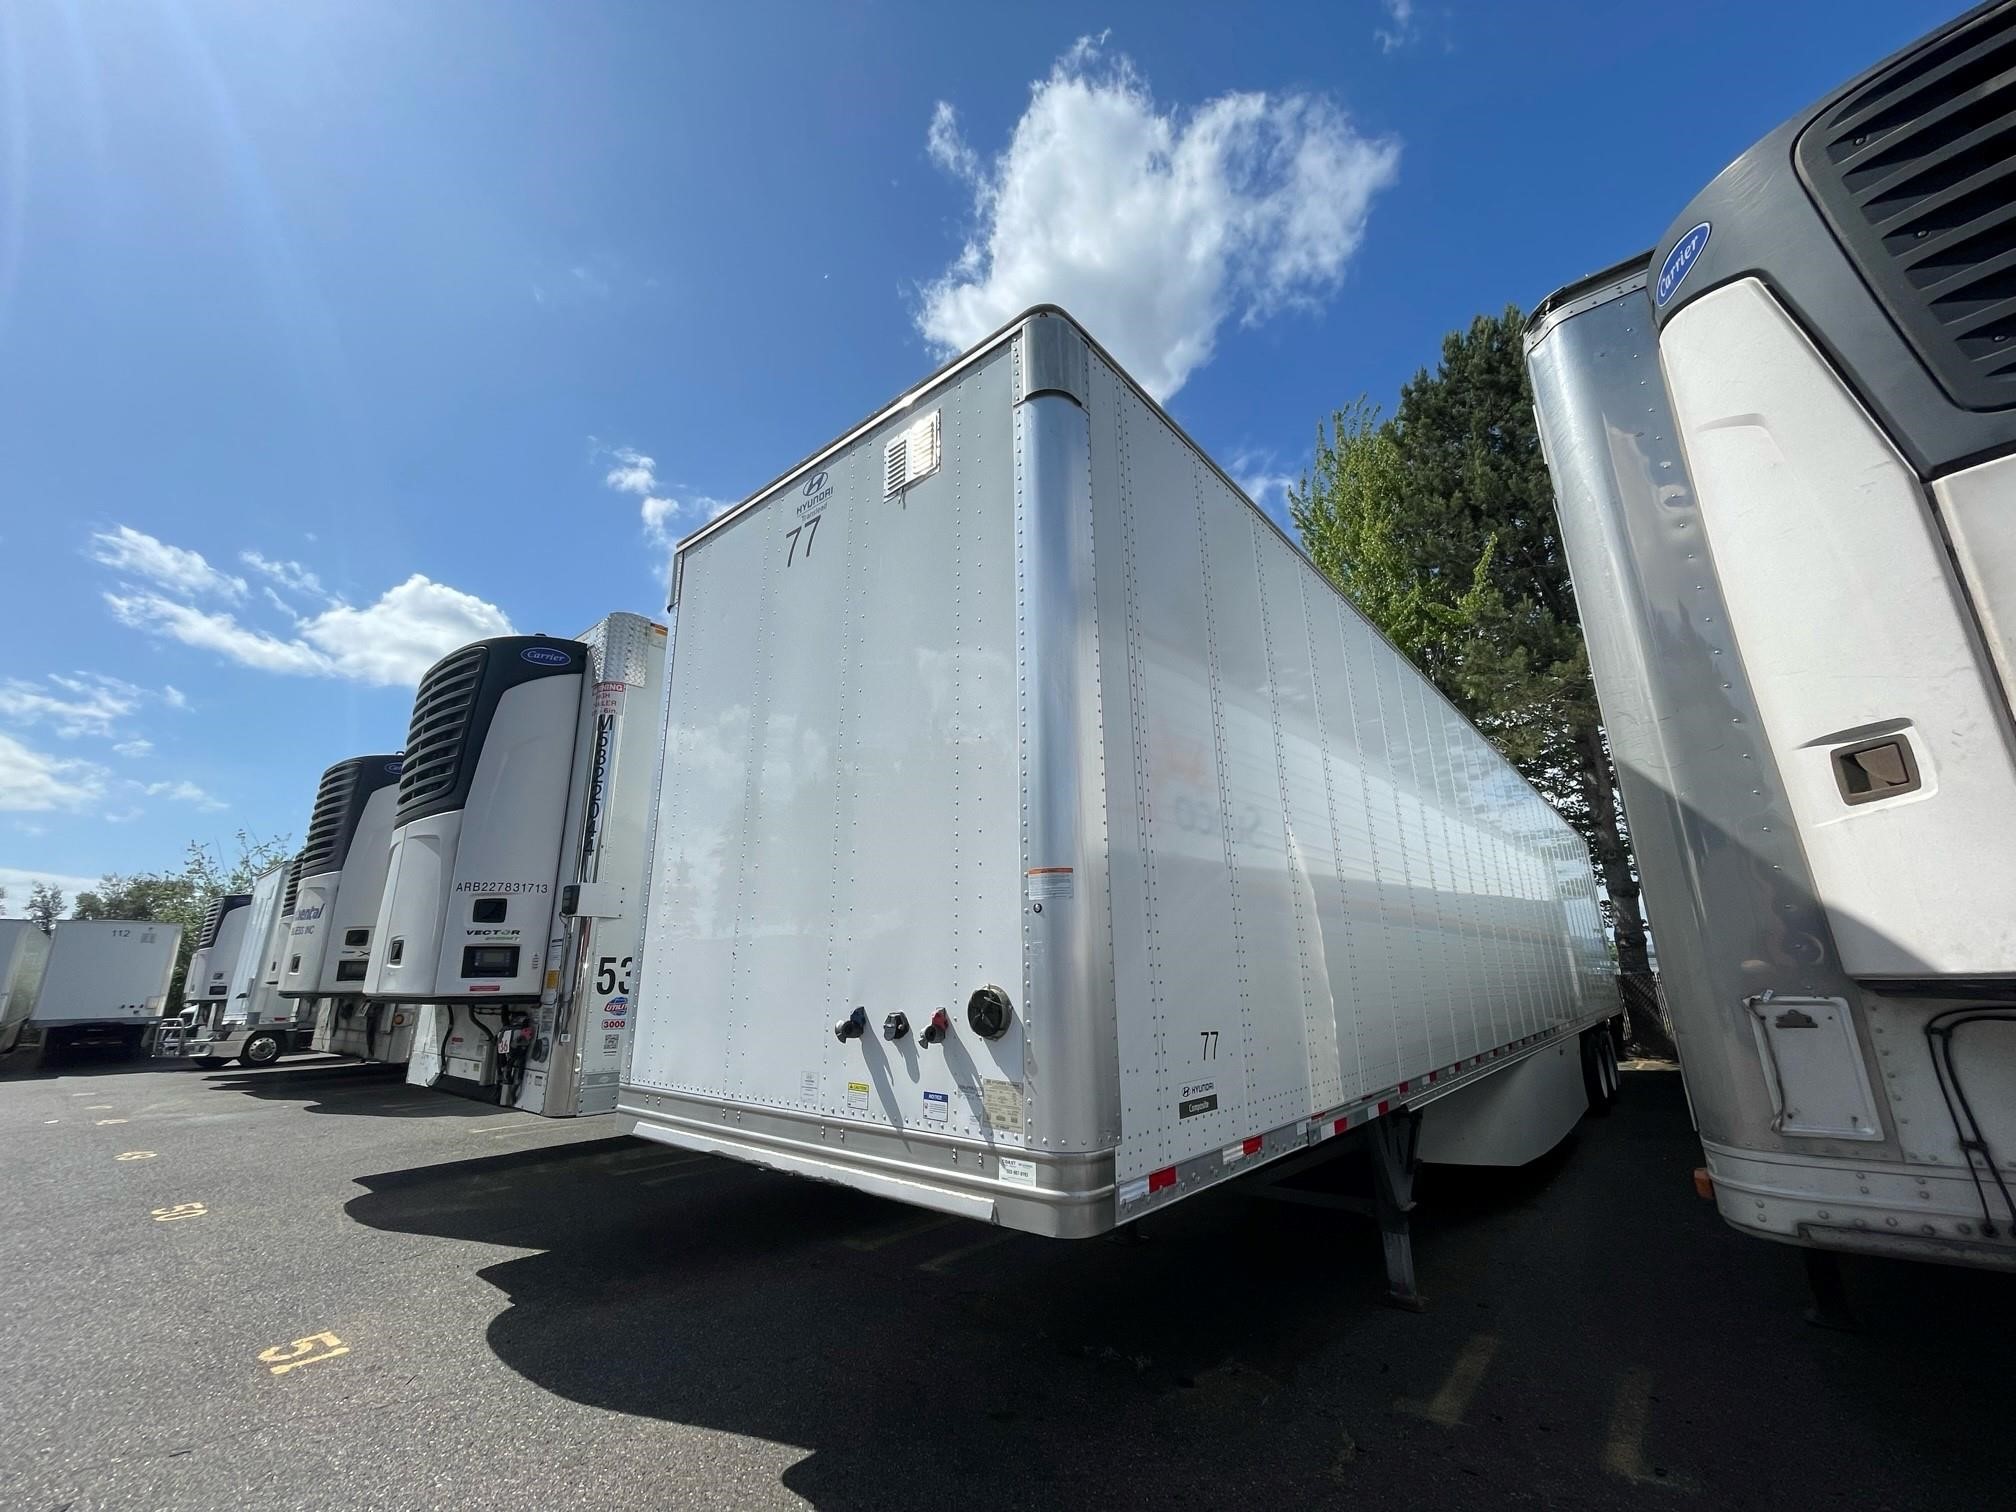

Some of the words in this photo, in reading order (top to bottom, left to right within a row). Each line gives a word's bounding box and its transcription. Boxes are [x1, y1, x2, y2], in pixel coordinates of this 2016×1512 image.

[1660, 235, 1699, 297] Carrier
[796, 486, 834, 515] HYUNDAI
[801, 503, 828, 522] Translead
[786, 515, 821, 568] 77
[527, 649, 566, 663] Carrier
[456, 882, 548, 894] ARB227831713
[112, 929, 131, 938] 112
[603, 1020, 626, 1029] 3000
[1200, 1031, 1219, 1061] 77
[1191, 1082, 1214, 1094] HYUNDAI
[259, 1331, 350, 1375] 51
